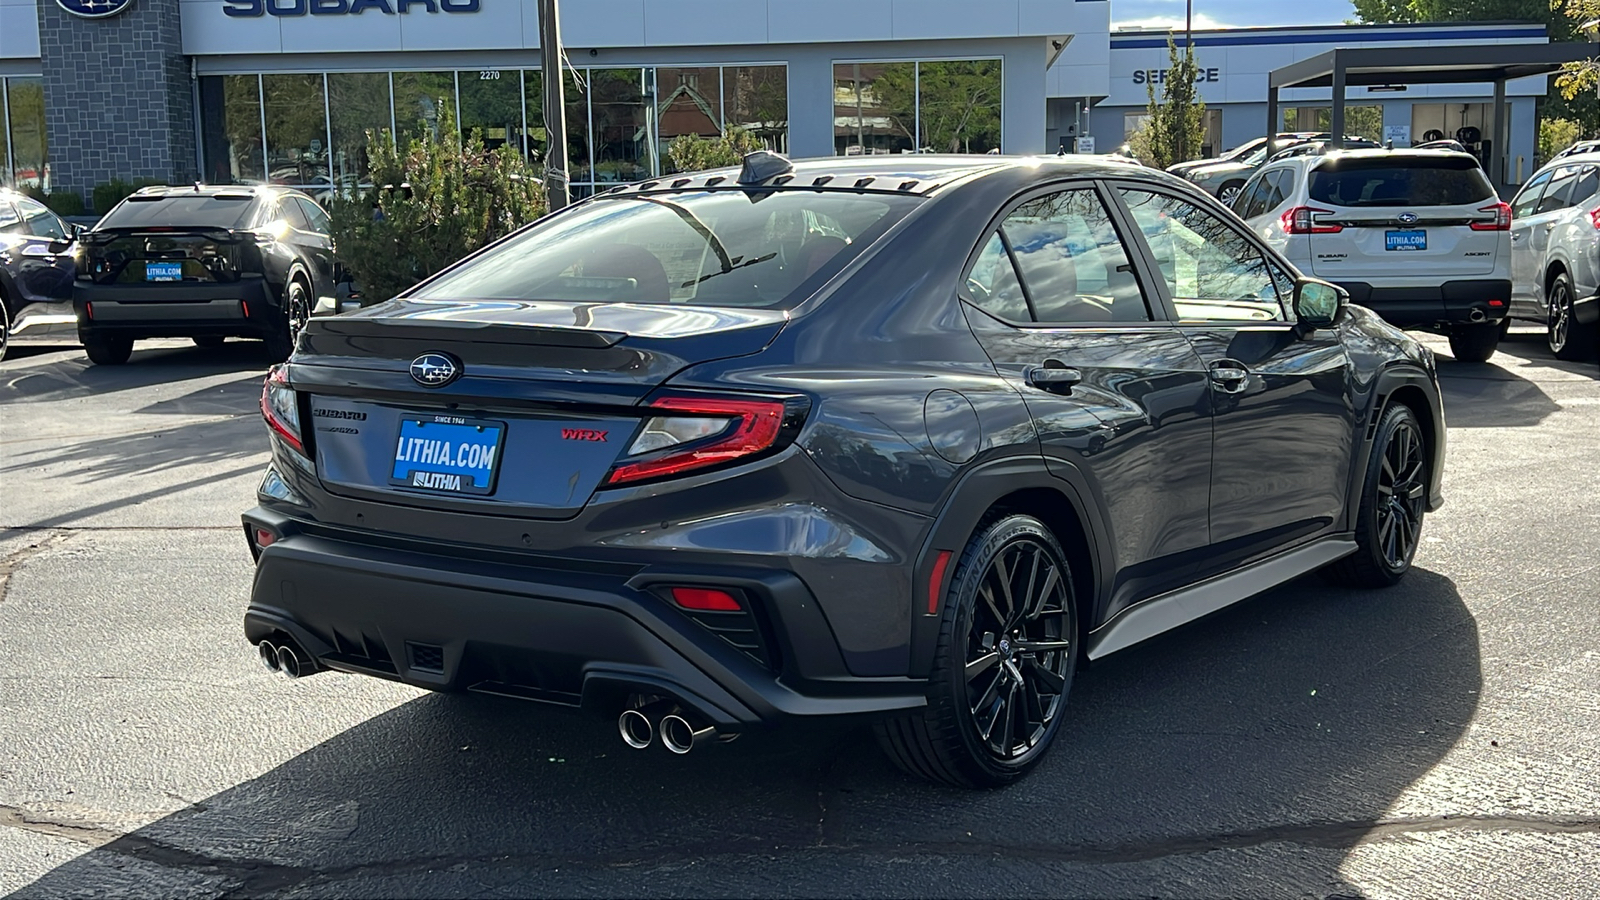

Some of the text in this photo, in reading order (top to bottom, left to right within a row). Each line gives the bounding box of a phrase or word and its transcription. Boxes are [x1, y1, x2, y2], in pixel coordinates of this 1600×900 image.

[480, 70, 500, 80] 2270
[1132, 68, 1219, 84] SERCE
[1386, 236, 1426, 245] LITHIA.COM
[313, 409, 367, 421] SUBARU
[434, 415, 465, 425] SINCE 1946
[562, 428, 609, 443] WRX
[396, 436, 496, 470] LITHIA.COM
[423, 472, 461, 491] LITHIA
